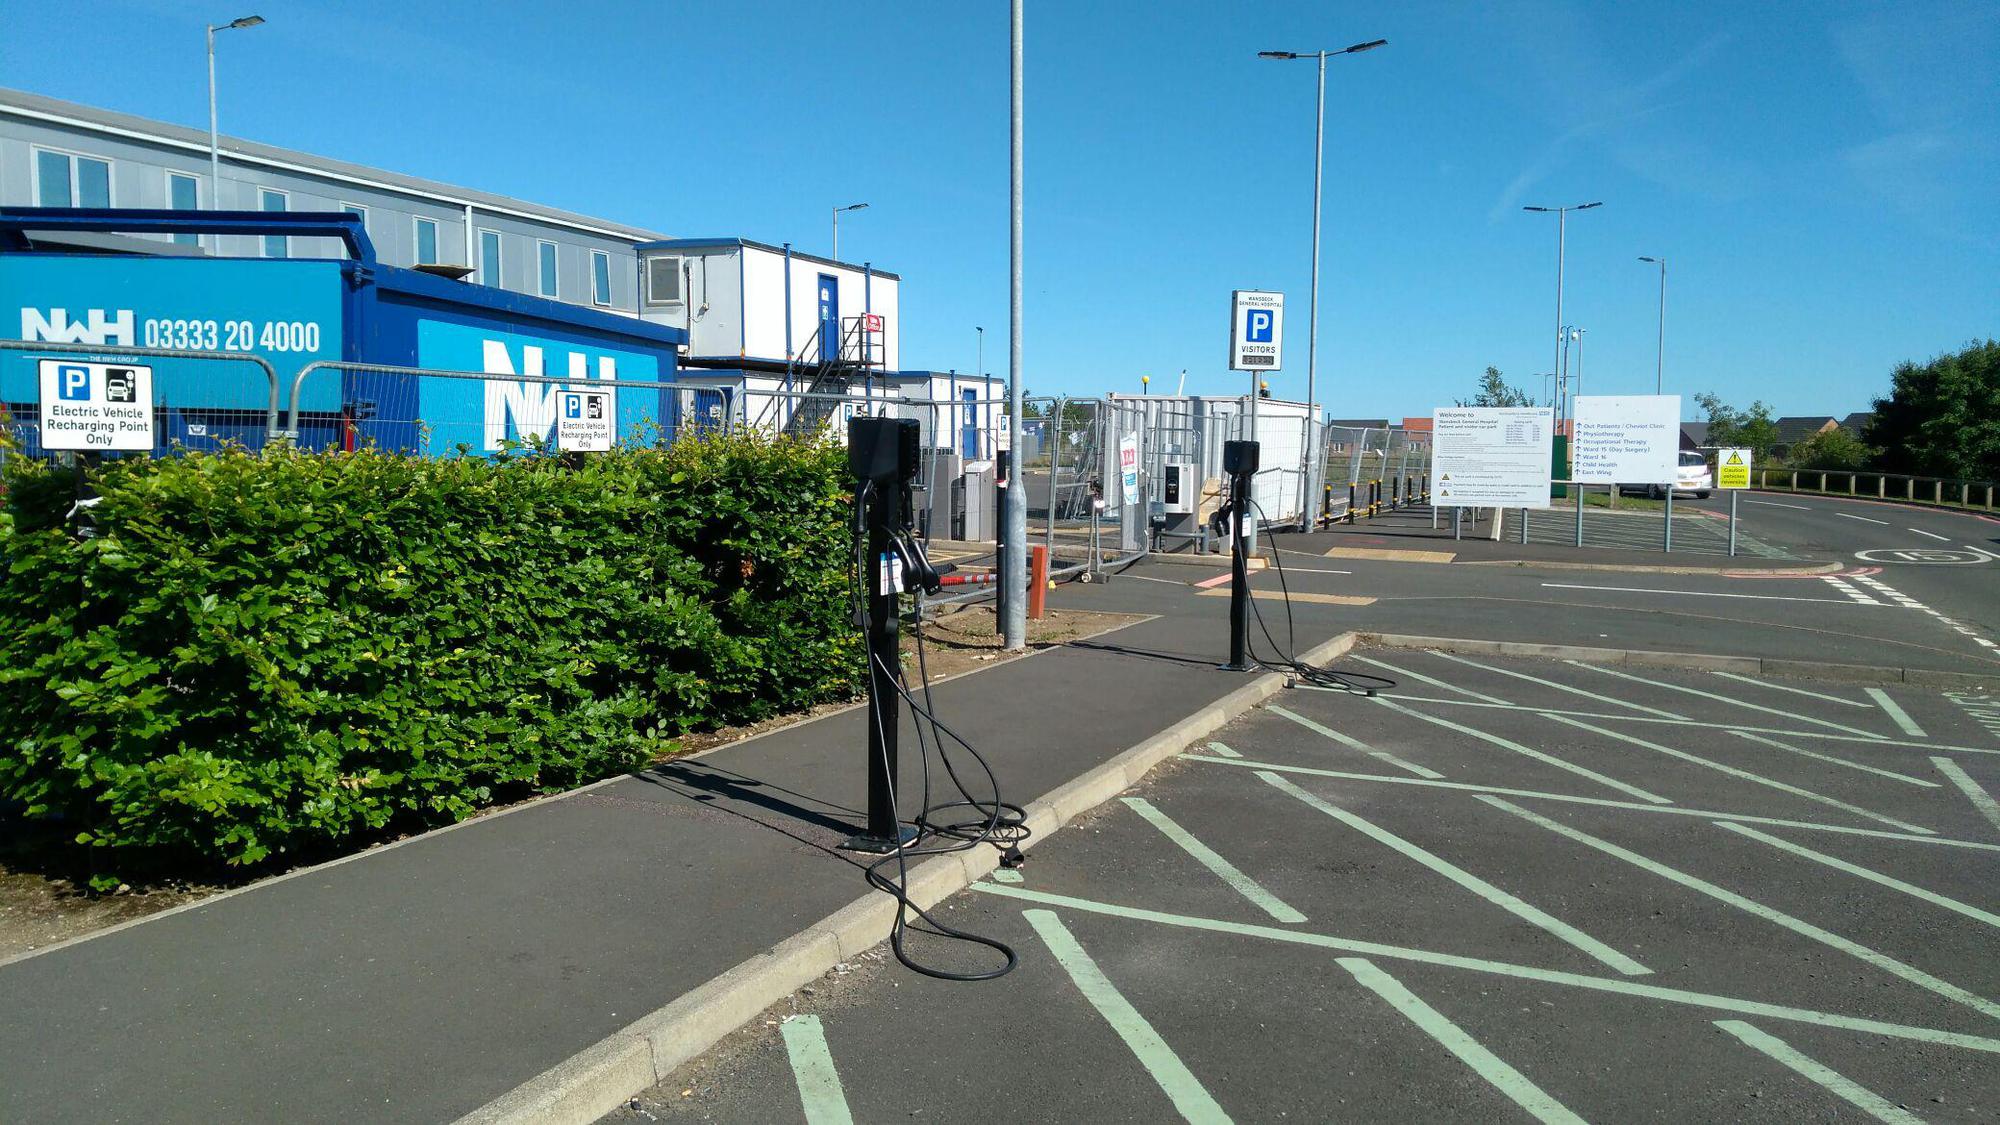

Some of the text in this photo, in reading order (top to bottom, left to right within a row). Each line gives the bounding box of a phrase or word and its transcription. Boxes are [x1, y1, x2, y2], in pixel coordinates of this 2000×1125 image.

[21, 308, 134, 346] NWH
[1252, 313, 1269, 339] P
[145, 319, 319, 352] 03333 20 4000
[66, 369, 86, 397] P
[53, 406, 143, 418] Electric Vehicle
[569, 397, 578, 416] P
[48, 419, 148, 432] Recharging Point
[86, 434, 112, 446] Only
[560, 431, 608, 440] Recharging Point
[579, 440, 591, 449] Only
[1894, 552, 1961, 560] 15
